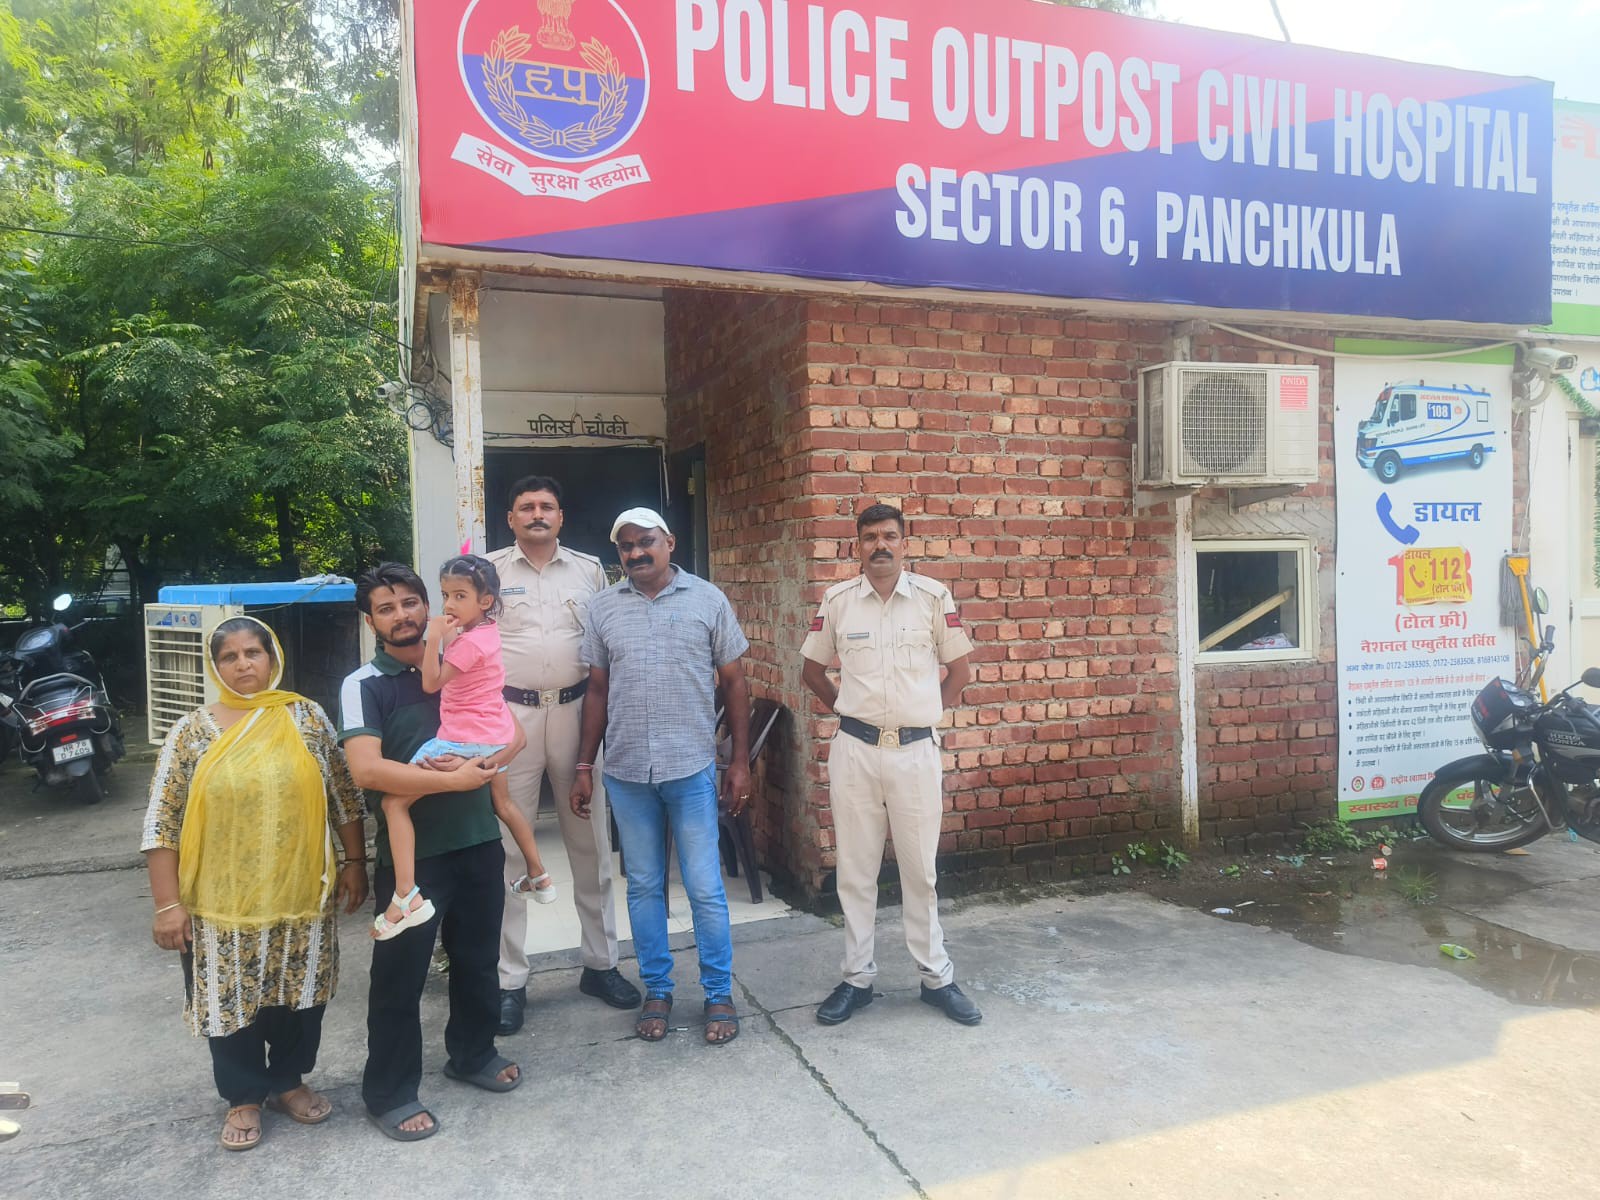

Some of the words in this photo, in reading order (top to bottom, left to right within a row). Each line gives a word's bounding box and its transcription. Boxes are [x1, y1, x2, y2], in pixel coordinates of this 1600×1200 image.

[676, 0, 910, 122] POLICE
[932, 26, 1181, 155] OUTPOST
[1197, 69, 1318, 172] CIVIL
[1334, 87, 1537, 194] HOSPITAL
[476, 146, 516, 177] सेवा
[529, 172, 580, 194] सुरक्षा
[585, 163, 642, 190] सहयोग
[895, 162, 1083, 253] SECTOR
[1099, 186, 1140, 267] 6,
[1156, 191, 1402, 276] PANCHKULA
[1281, 376, 1306, 385] ONIDA
[1432, 404, 1449, 417] 108
[584, 412, 629, 435] चौकी
[1413, 502, 1482, 522] डायल
[1429, 557, 1462, 581] 112
[1395, 612, 1434, 632] (टोल
[1440, 610, 1467, 630] फ्री)
[1361, 639, 1407, 653] नेशनल
[1462, 633, 1496, 648] सर्विस
[1348, 800, 1399, 813] स्वास्थ्य
